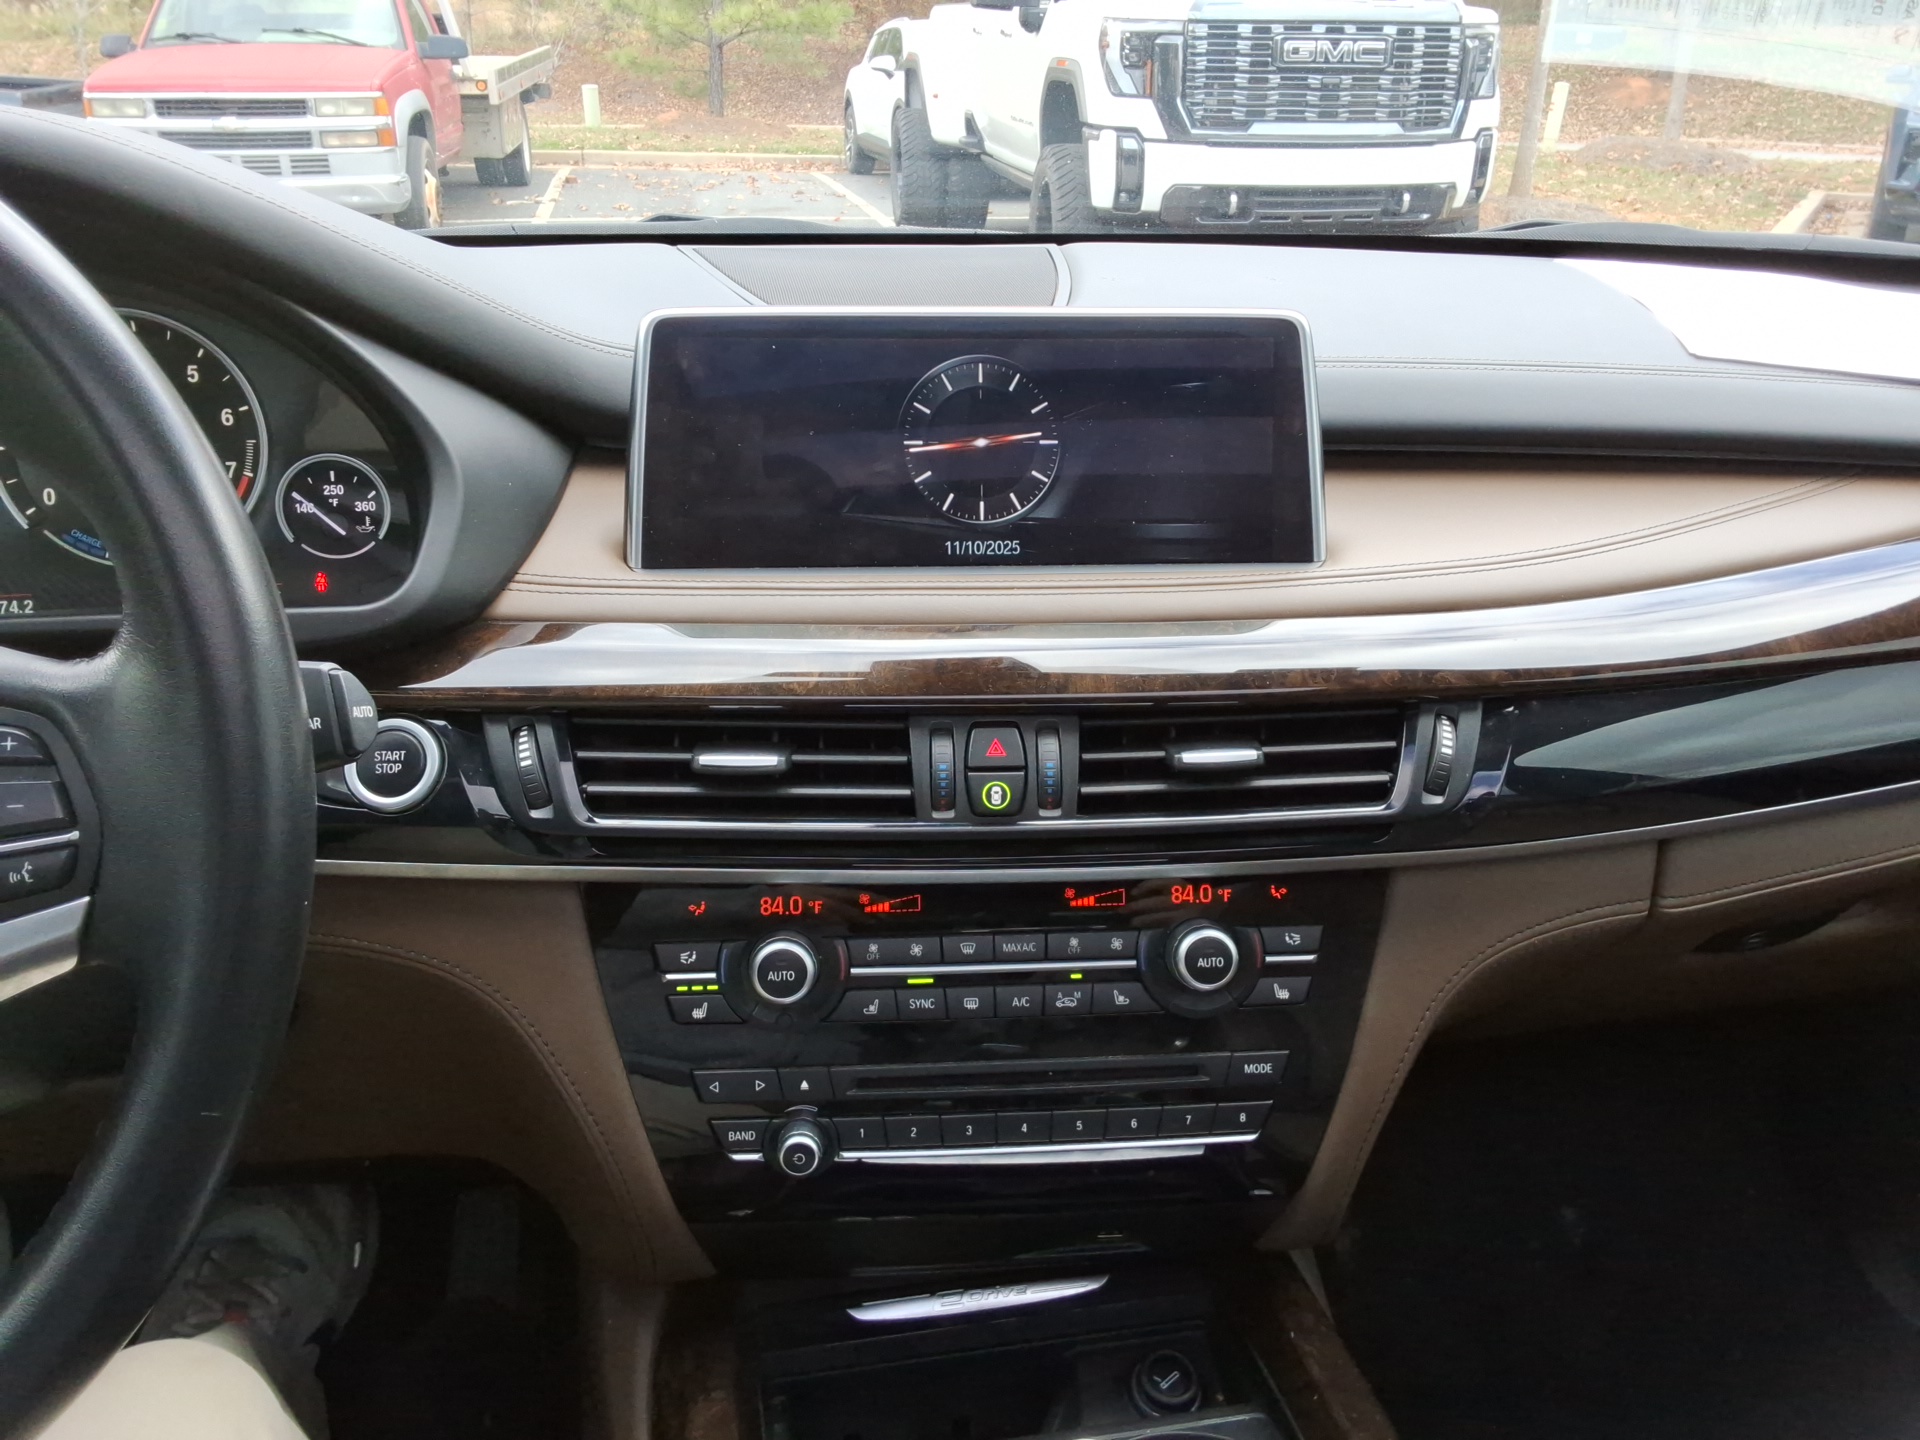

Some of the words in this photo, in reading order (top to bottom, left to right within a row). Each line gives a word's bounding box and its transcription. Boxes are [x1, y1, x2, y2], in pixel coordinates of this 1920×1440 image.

[1283, 39, 1387, 64] GMC
[187, 364, 199, 383] 5
[220, 408, 234, 426] 6
[225, 461, 237, 479] 7
[322, 484, 345, 496] 250
[42, 487, 56, 506] 0
[354, 500, 376, 512] 360
[944, 540, 1021, 555] 11/10/2025
[352, 705, 374, 718] AUTO
[373, 750, 407, 762] START
[375, 762, 403, 774] STOP
[1171, 884, 1213, 904] 84.0
[760, 895, 803, 916] 84.0
[1197, 956, 1225, 968] AUTO
[767, 970, 796, 982] AUTO
[909, 998, 936, 1009] SYNC
[1012, 996, 1030, 1008] A/C
[1244, 1063, 1273, 1074] MODE
[1130, 1118, 1138, 1129] 6
[1185, 1115, 1192, 1126] 7
[1239, 1112, 1247, 1123] 8
[965, 1125, 973, 1136] 3
[1021, 1123, 1028, 1133] 4
[1076, 1120, 1083, 1131] 5
[728, 1130, 756, 1142] BAND
[910, 1127, 917, 1138] 2
